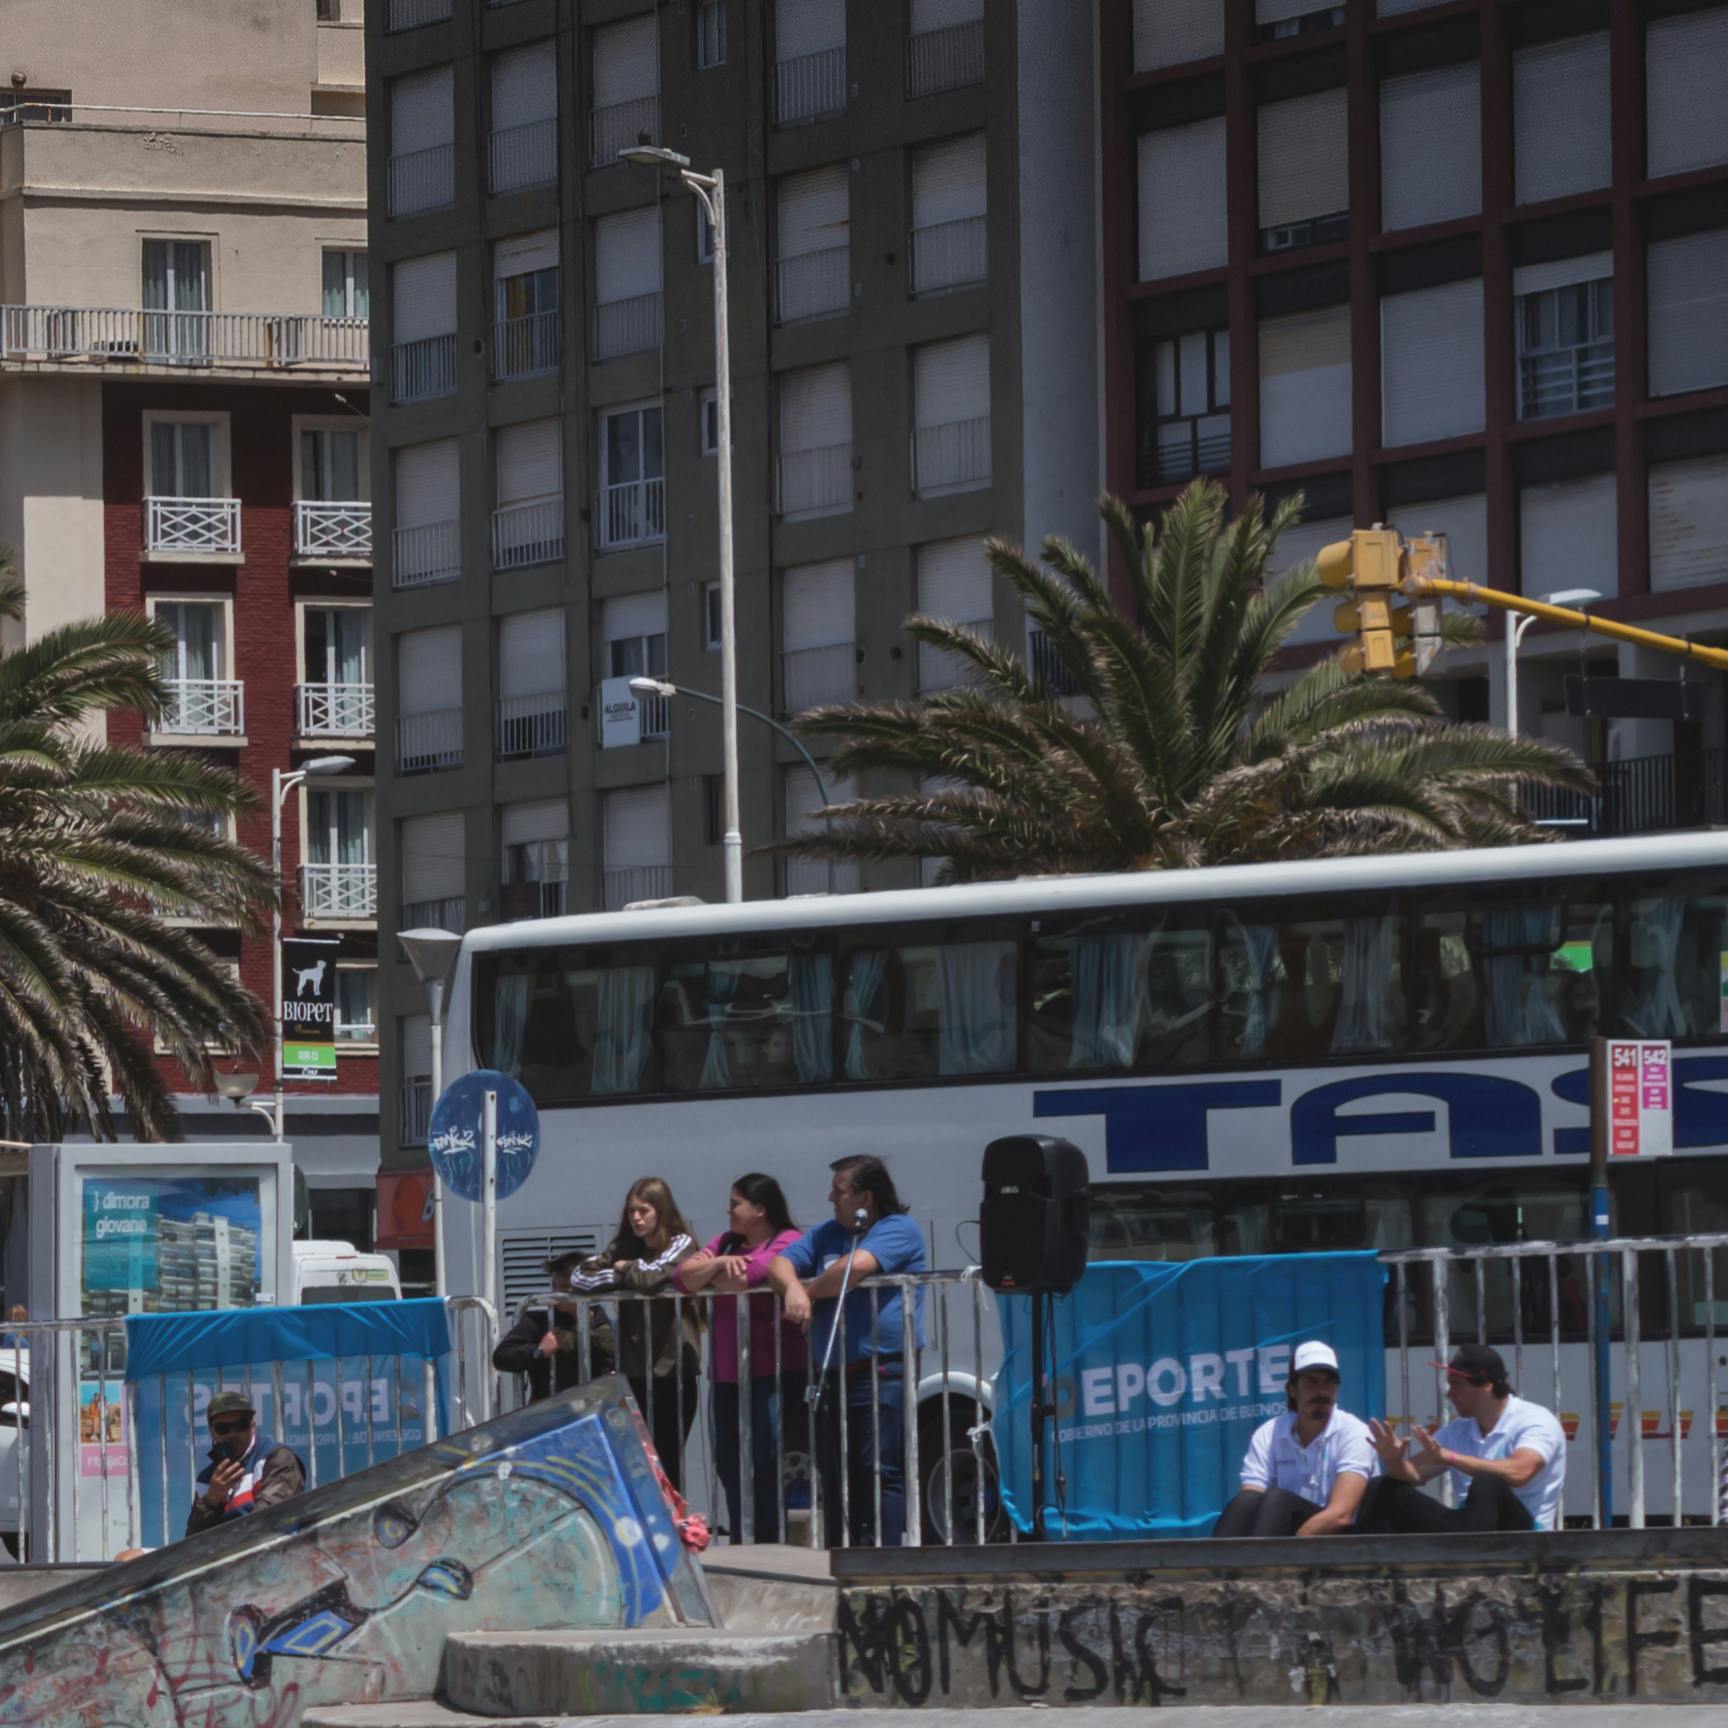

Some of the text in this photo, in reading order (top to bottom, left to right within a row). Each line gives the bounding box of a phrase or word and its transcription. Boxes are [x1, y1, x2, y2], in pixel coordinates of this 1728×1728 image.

[103, 1192, 150, 1209] dimora
[96, 1217, 147, 1239] giovane
[1148, 1411, 1218, 1431] PROVINCIA
